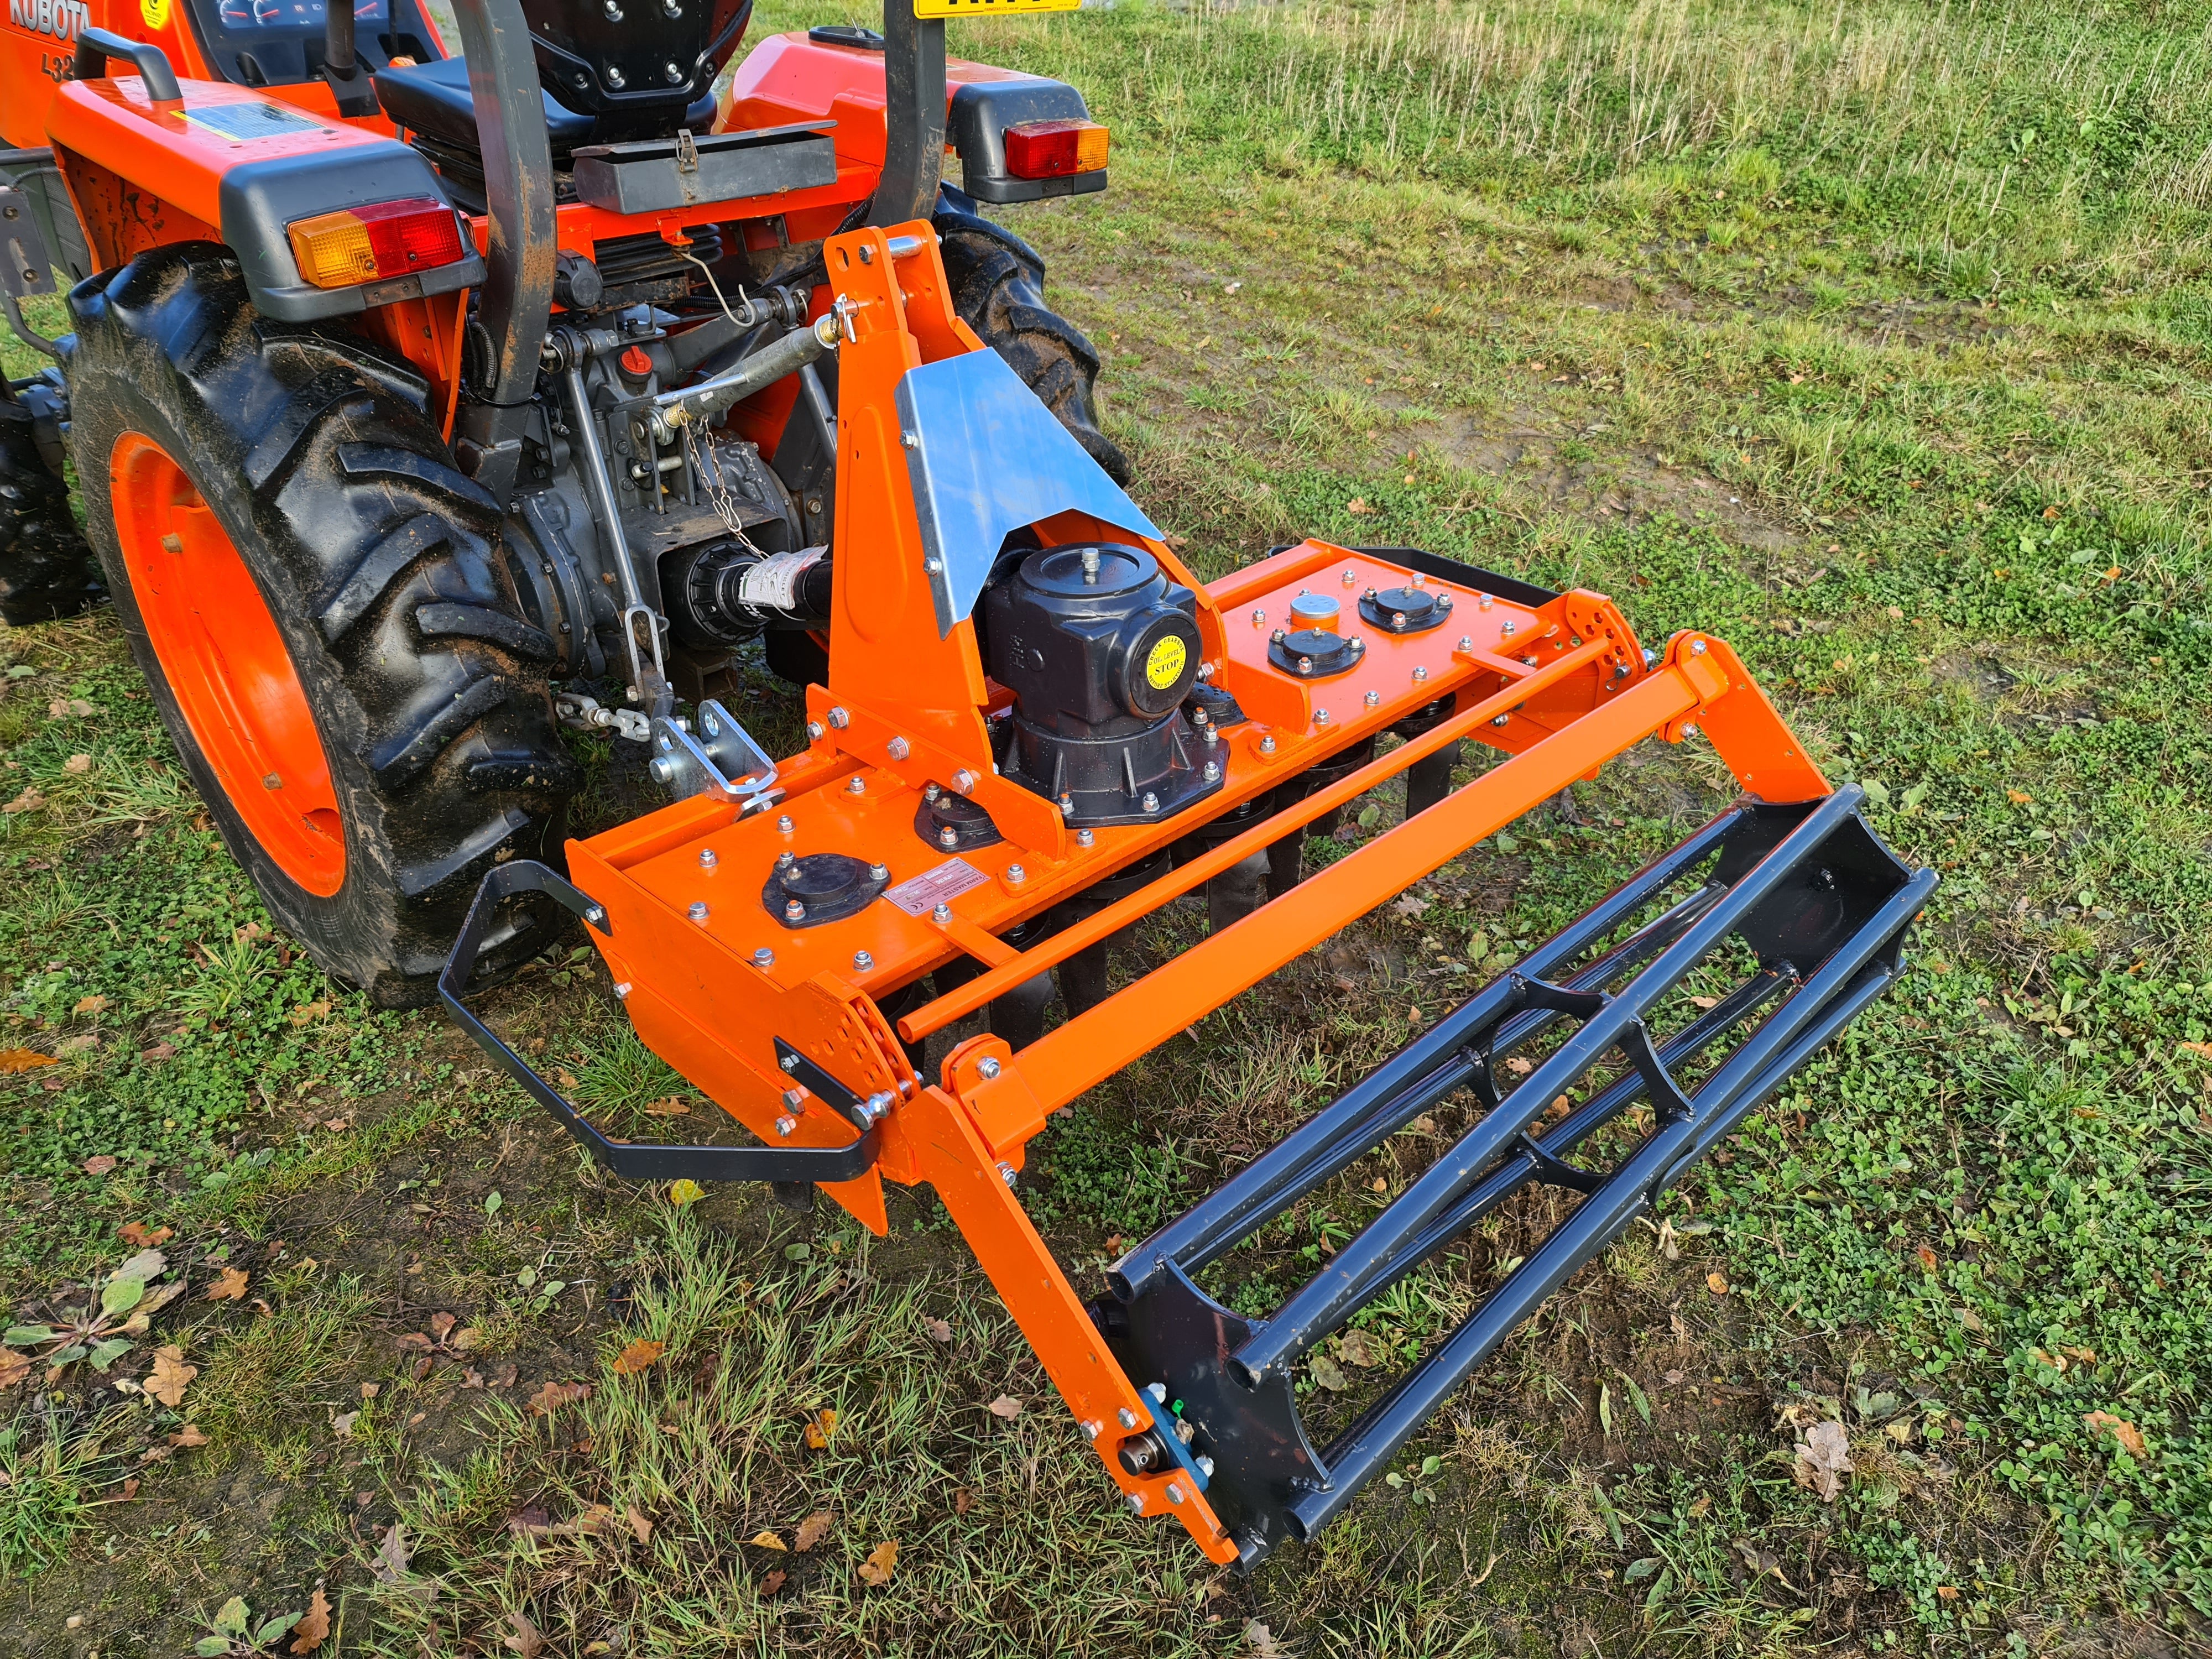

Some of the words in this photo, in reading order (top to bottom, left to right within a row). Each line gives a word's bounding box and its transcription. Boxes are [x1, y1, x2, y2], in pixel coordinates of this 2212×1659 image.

[10, 0, 91, 43] KUBOTA
[1149, 643, 1162, 665] CHECK
[1164, 637, 1184, 652] GEARBOX
[1154, 656, 1162, 664] OIL
[1164, 649, 1181, 660] LEVEL
[1155, 659, 1179, 676] STOP
[1149, 675, 1164, 688] BEFORE
[966, 875, 983, 885] FARM
[942, 883, 967, 896] MASTER
